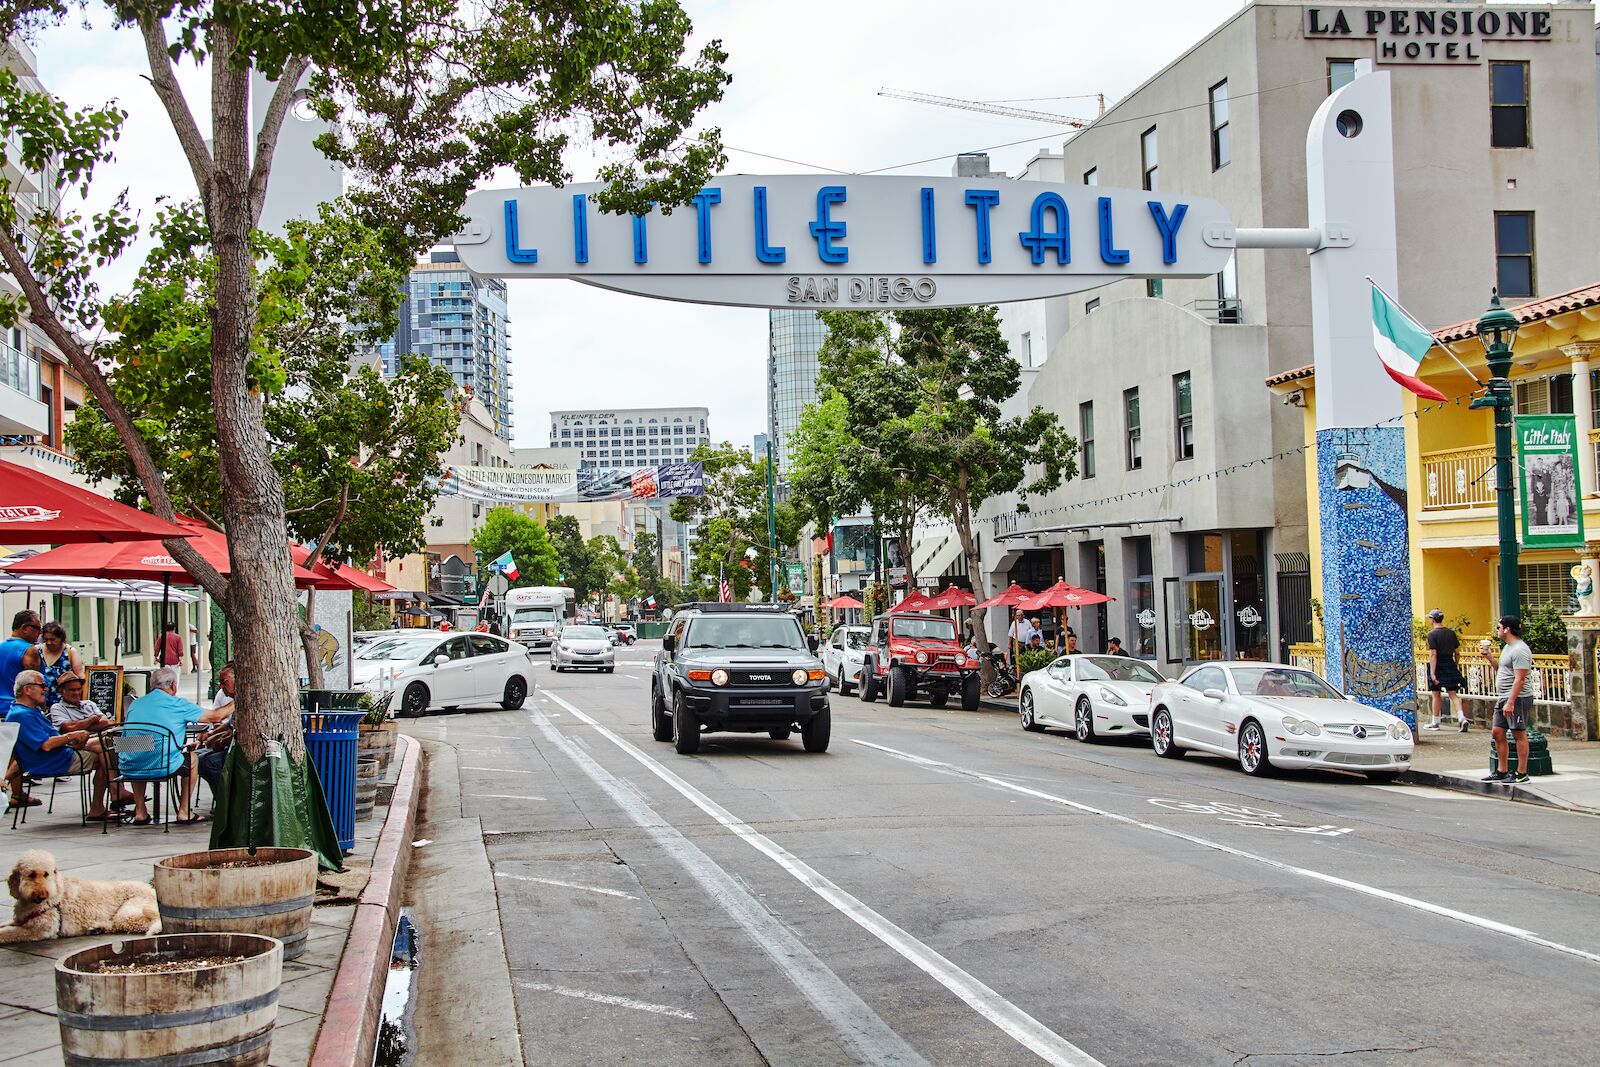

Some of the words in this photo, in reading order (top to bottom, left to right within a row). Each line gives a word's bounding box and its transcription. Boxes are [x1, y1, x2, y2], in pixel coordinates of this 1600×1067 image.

[1309, 9, 1352, 34] LA
[1365, 10, 1551, 36] PENSIONE
[1383, 42, 1480, 59] HOTEL
[920, 187, 1190, 265] ITALY
[787, 276, 839, 302] SAN
[848, 277, 937, 302] DIEGO
[1523, 423, 1550, 445] Little
[1550, 420, 1572, 454] Italy
[465, 470, 486, 482] LITTLE
[487, 471, 504, 483] ITALY
[505, 472, 544, 484] WEDNESDAY
[545, 473, 572, 484] MARKET
